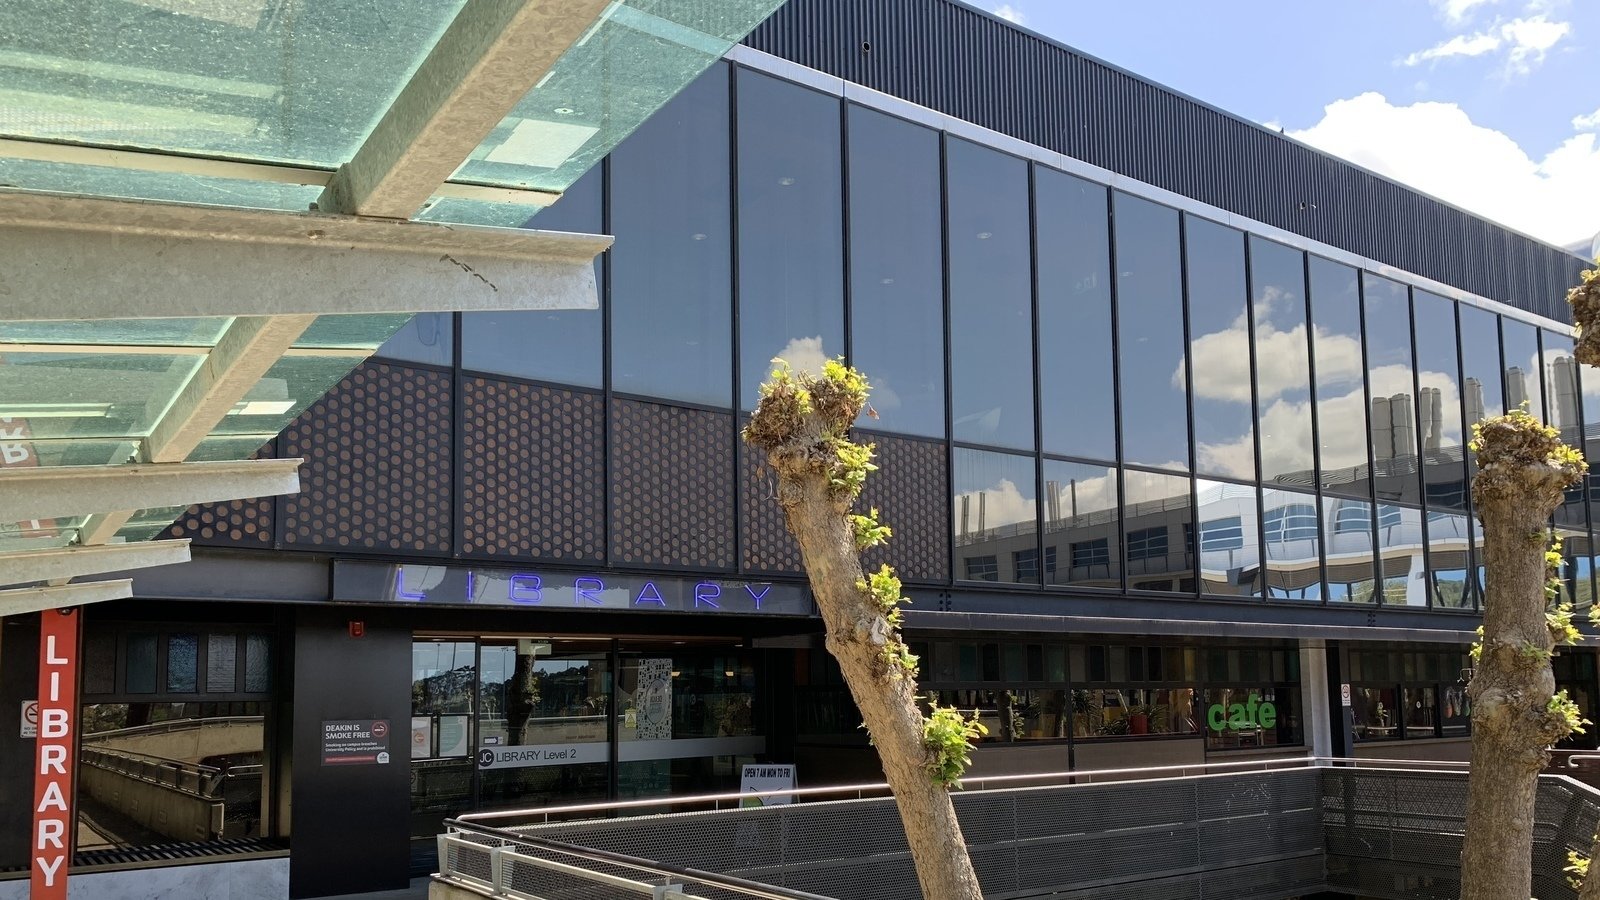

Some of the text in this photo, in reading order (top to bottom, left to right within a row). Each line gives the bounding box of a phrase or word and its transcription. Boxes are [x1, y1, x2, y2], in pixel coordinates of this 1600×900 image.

[398, 567, 773, 609] LIBRARY
[1208, 693, 1276, 731] cafe
[325, 724, 352, 732] DEAKIN
[325, 731, 370, 740] SMOKE FREE
[36, 635, 69, 887] LIBRARY
[480, 748, 577, 763] JC LIBRARY Level 2
[744, 768, 791, 778] OPEN 7 AM MON TO FRI
